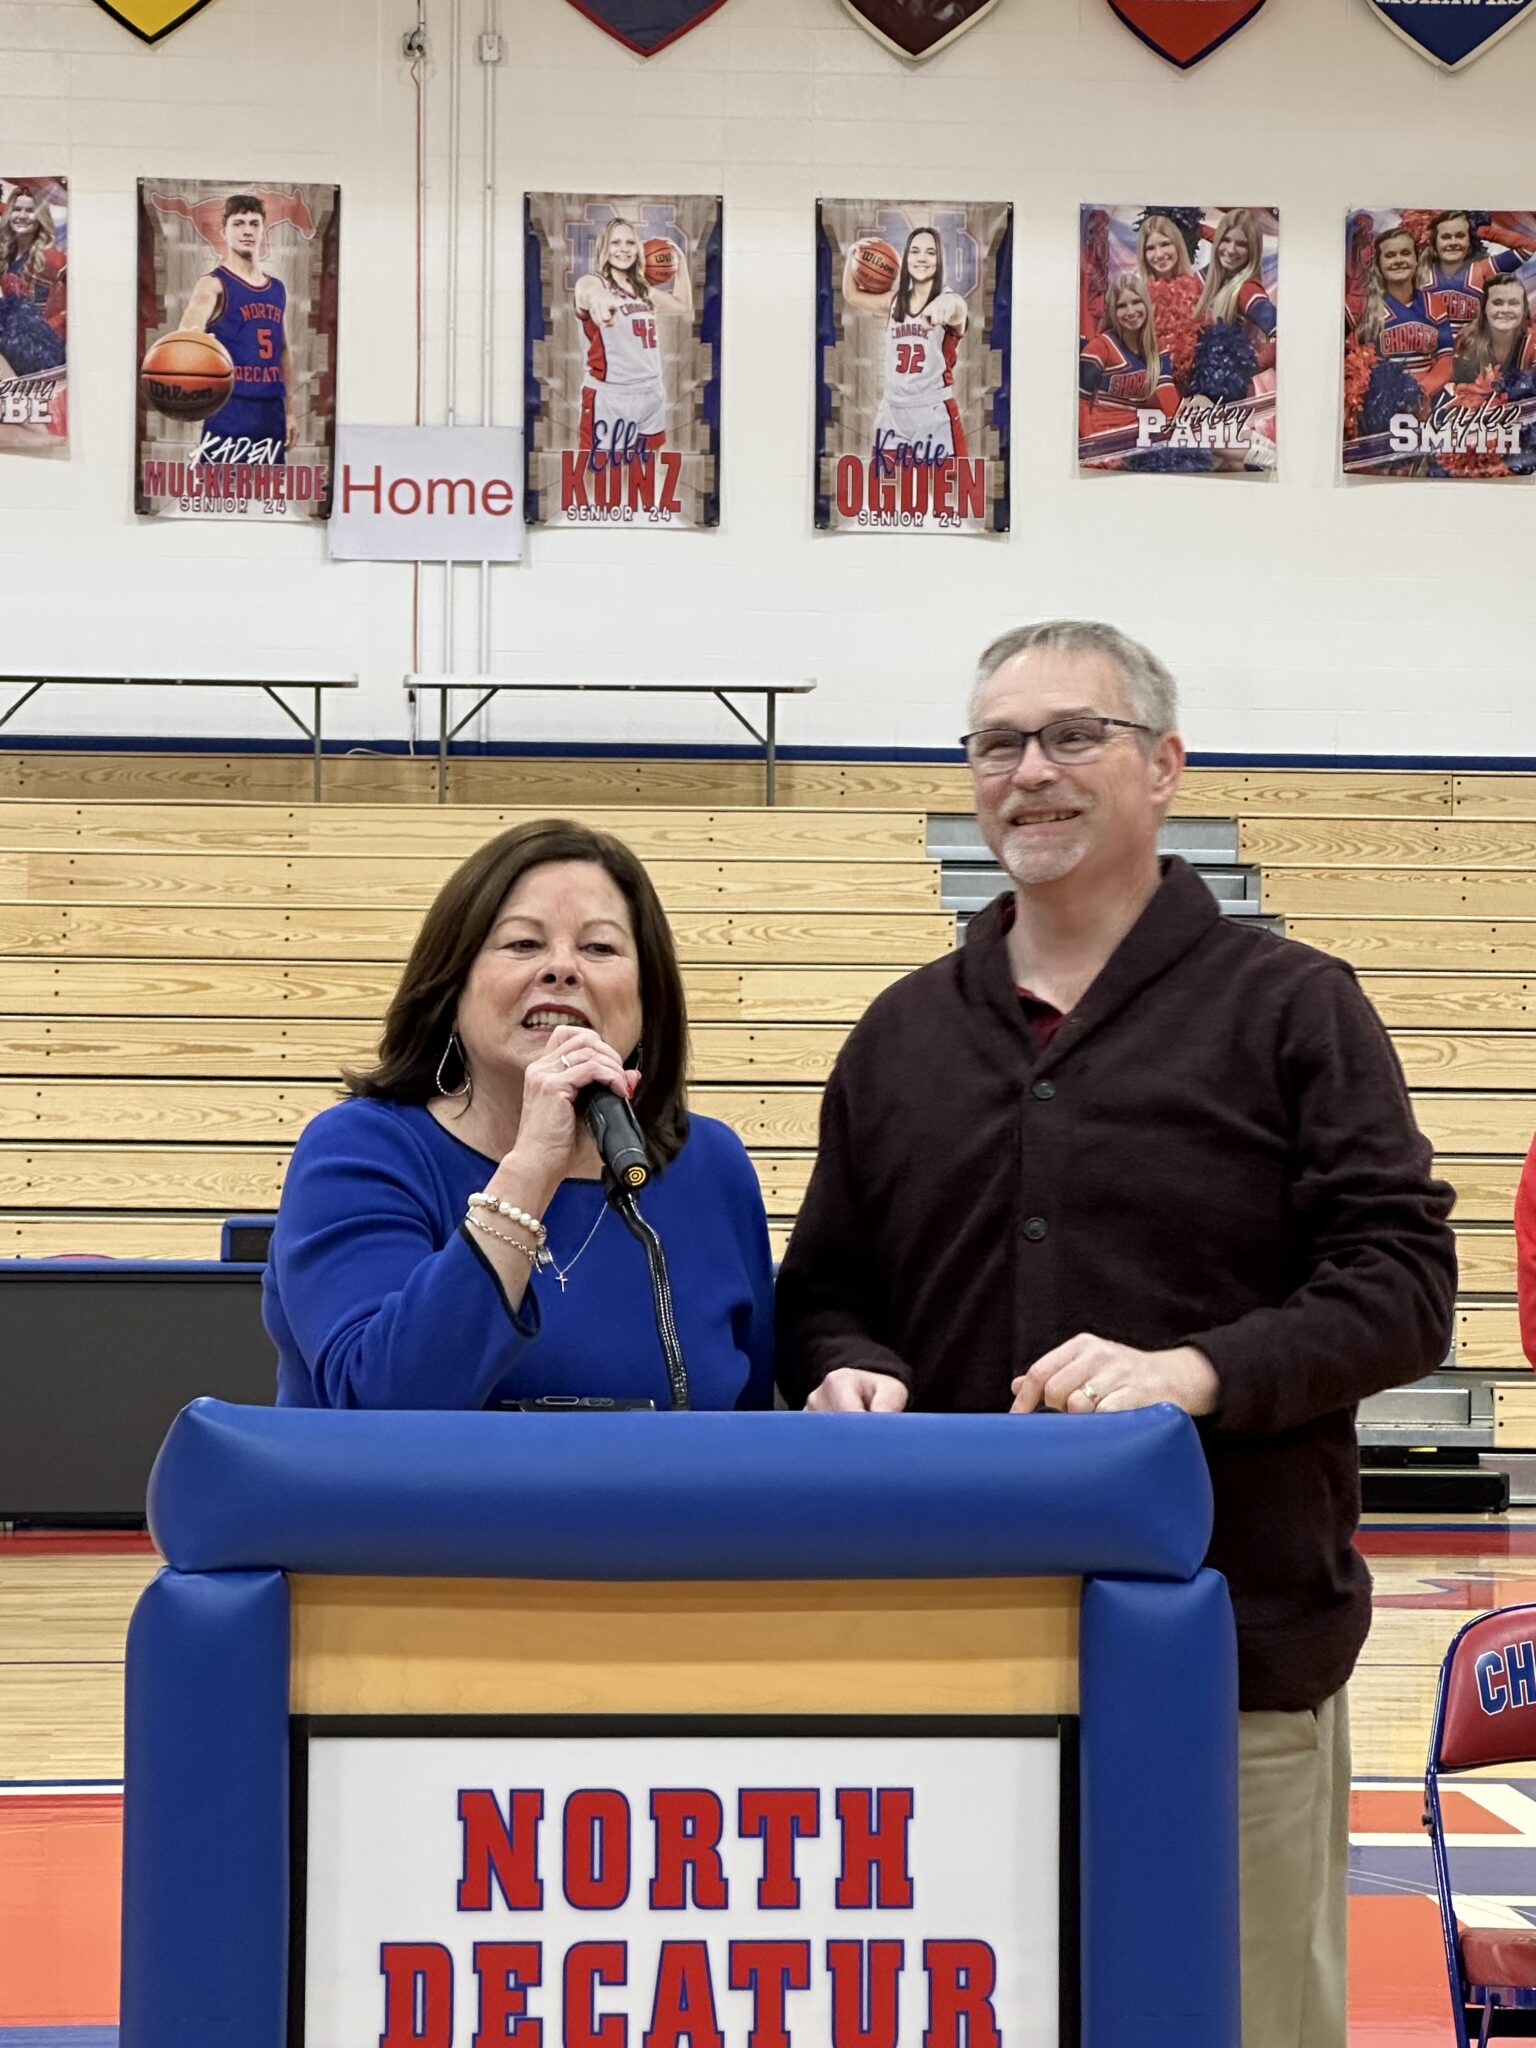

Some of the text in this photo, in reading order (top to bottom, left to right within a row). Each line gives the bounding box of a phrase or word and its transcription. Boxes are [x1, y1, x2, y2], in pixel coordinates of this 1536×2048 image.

[862, 250, 895, 276] Wilson
[240, 302, 282, 324] NORTH
[257, 328, 273, 360] 5
[631, 318, 657, 350] 42
[896, 344, 926, 374] 32
[1136, 408, 1250, 449] PAHL
[1160, 395, 1255, 441] Lindsey
[1389, 413, 1523, 455] SMITH
[1427, 391, 1522, 448] Kaylee
[189, 431, 282, 471] KADEN
[588, 418, 652, 473] Ella
[873, 428, 950, 479] Kacie
[143, 461, 328, 502] MUCKERHEIDE
[342, 464, 514, 517] Home
[561, 450, 682, 513] KUNZ
[836, 453, 986, 519] OGDEN
[179, 496, 249, 514] SENIOR
[567, 505, 634, 521] SENIOR
[857, 509, 924, 527] SENIOR
[457, 1787, 914, 1912] NORTH
[379, 1940, 1002, 2048] DECATUR
